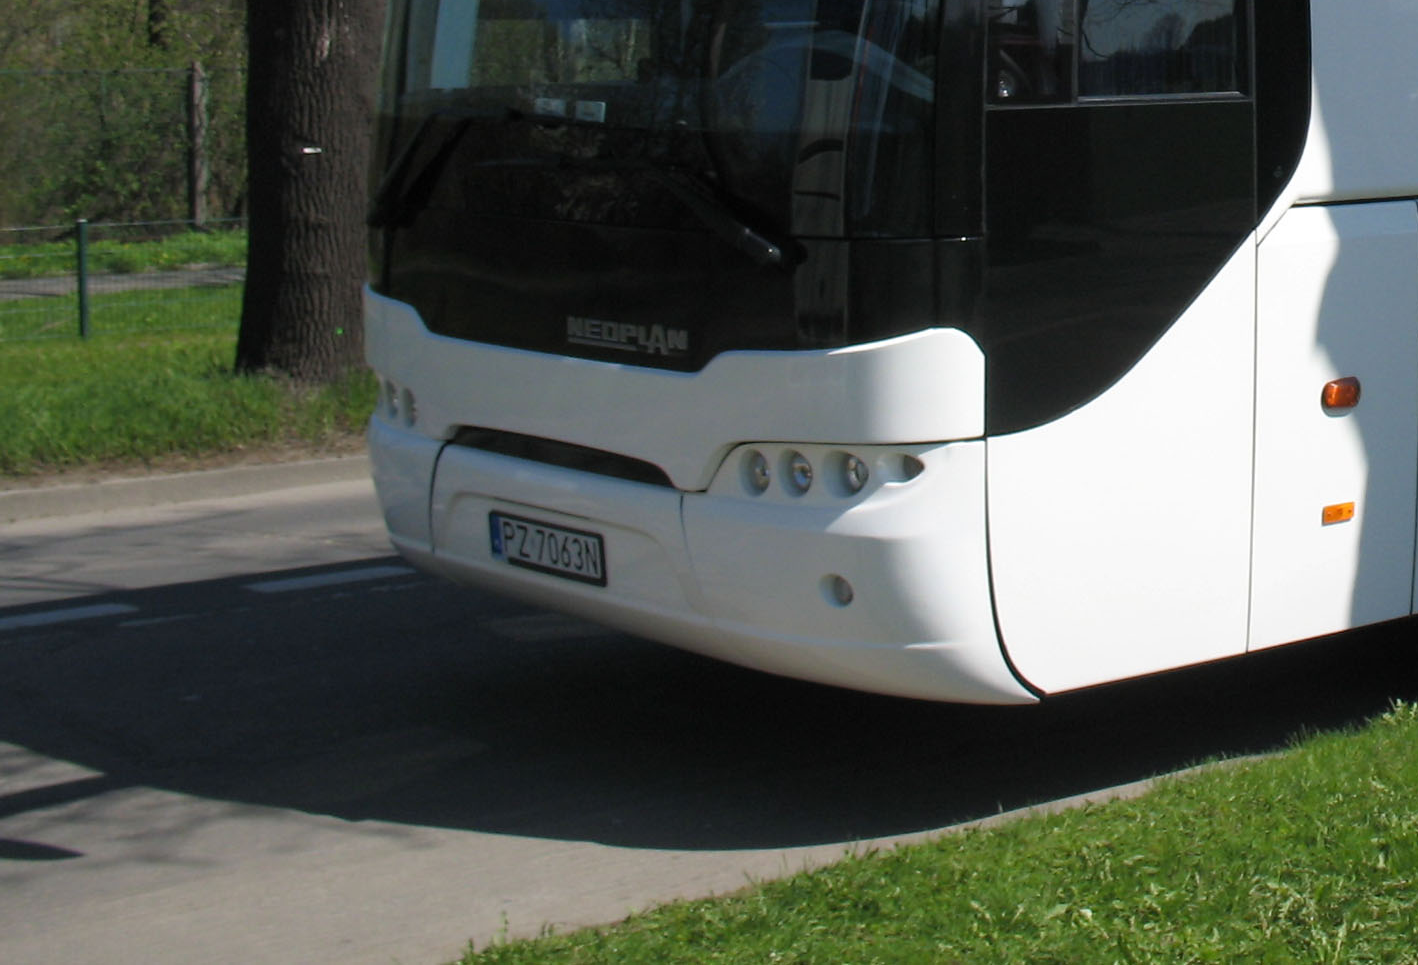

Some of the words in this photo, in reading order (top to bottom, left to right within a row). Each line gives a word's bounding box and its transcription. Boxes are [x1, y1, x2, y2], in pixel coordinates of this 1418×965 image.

[566, 316, 689, 355] NEOPLAN
[502, 521, 531, 559] PZ
[536, 529, 599, 575] 7063N
